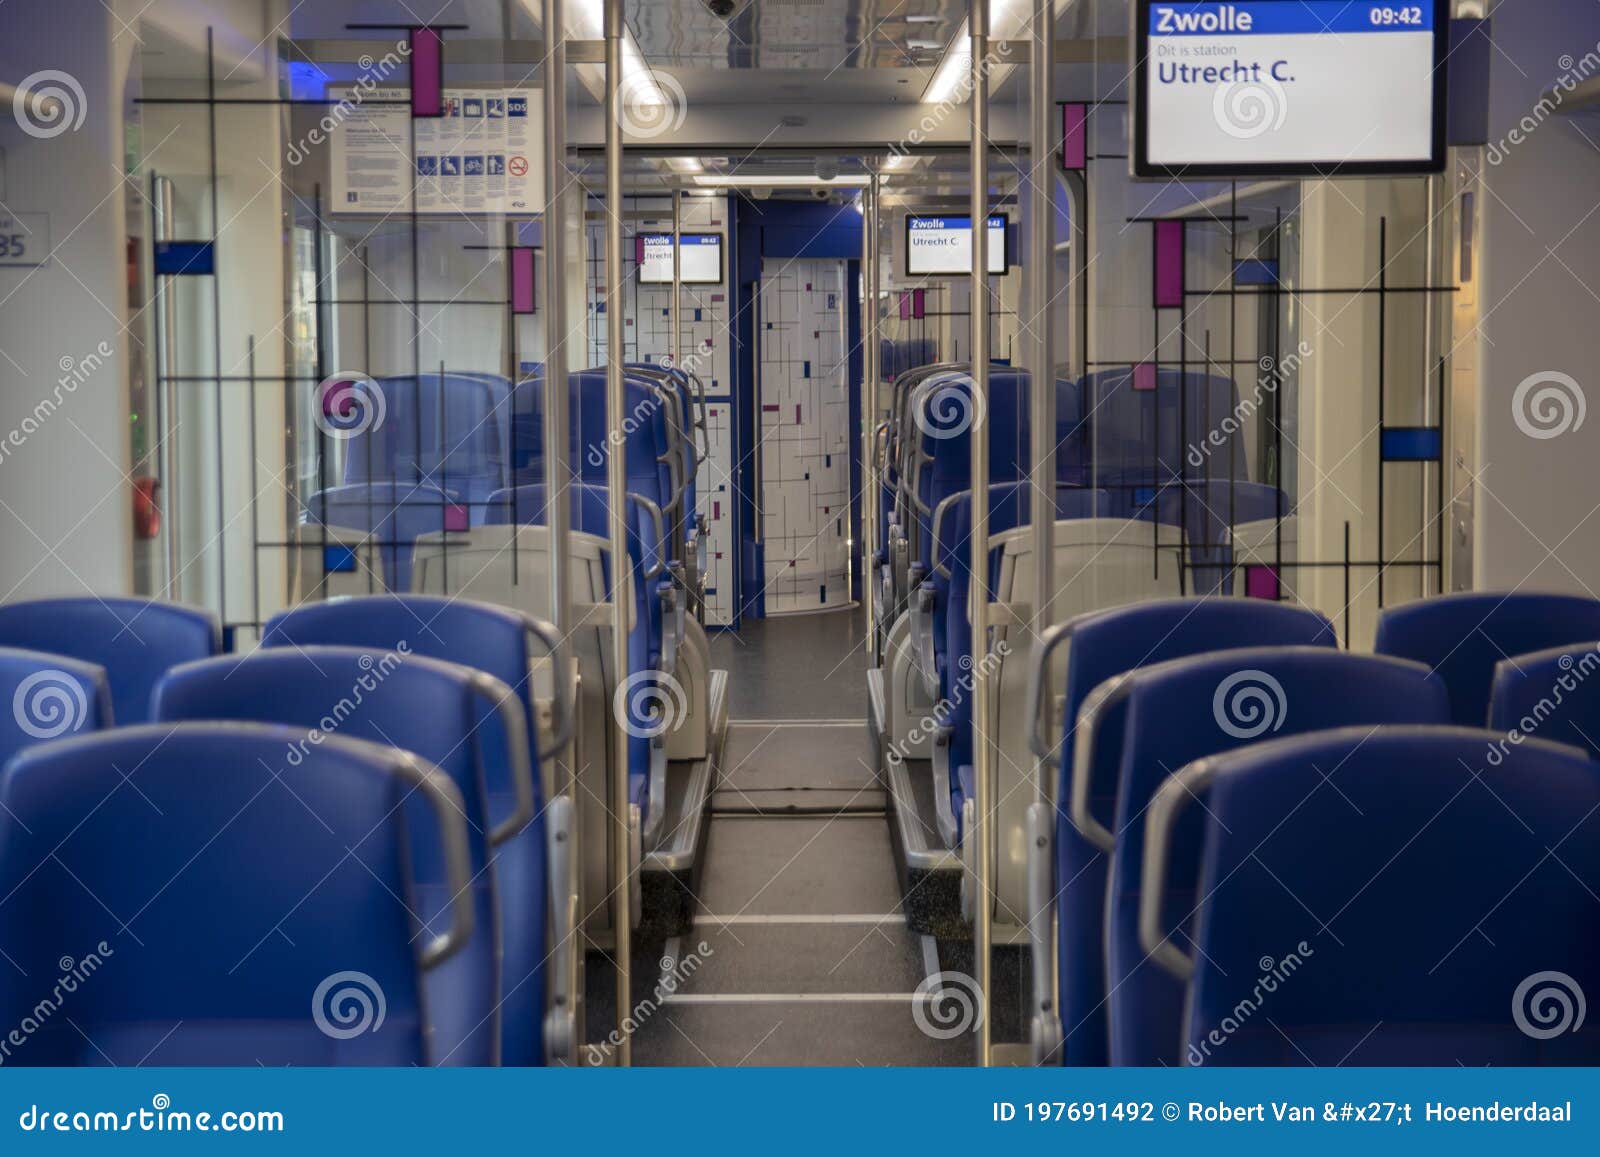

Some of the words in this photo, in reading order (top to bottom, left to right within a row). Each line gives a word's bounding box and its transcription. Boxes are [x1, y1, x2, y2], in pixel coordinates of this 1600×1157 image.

[1156, 5, 1253, 32] Zwolle
[1370, 7, 1422, 25] 09:42
[1157, 44, 1176, 57] Dit
[1180, 45, 1190, 56] is
[1194, 44, 1237, 57] station
[1158, 59, 1261, 84] Utrecht
[1271, 60, 1295, 82] C.
[508, 103, 527, 112] SOS
[912, 219, 945, 229] Zwolle
[913, 237, 948, 246] Utrecht
